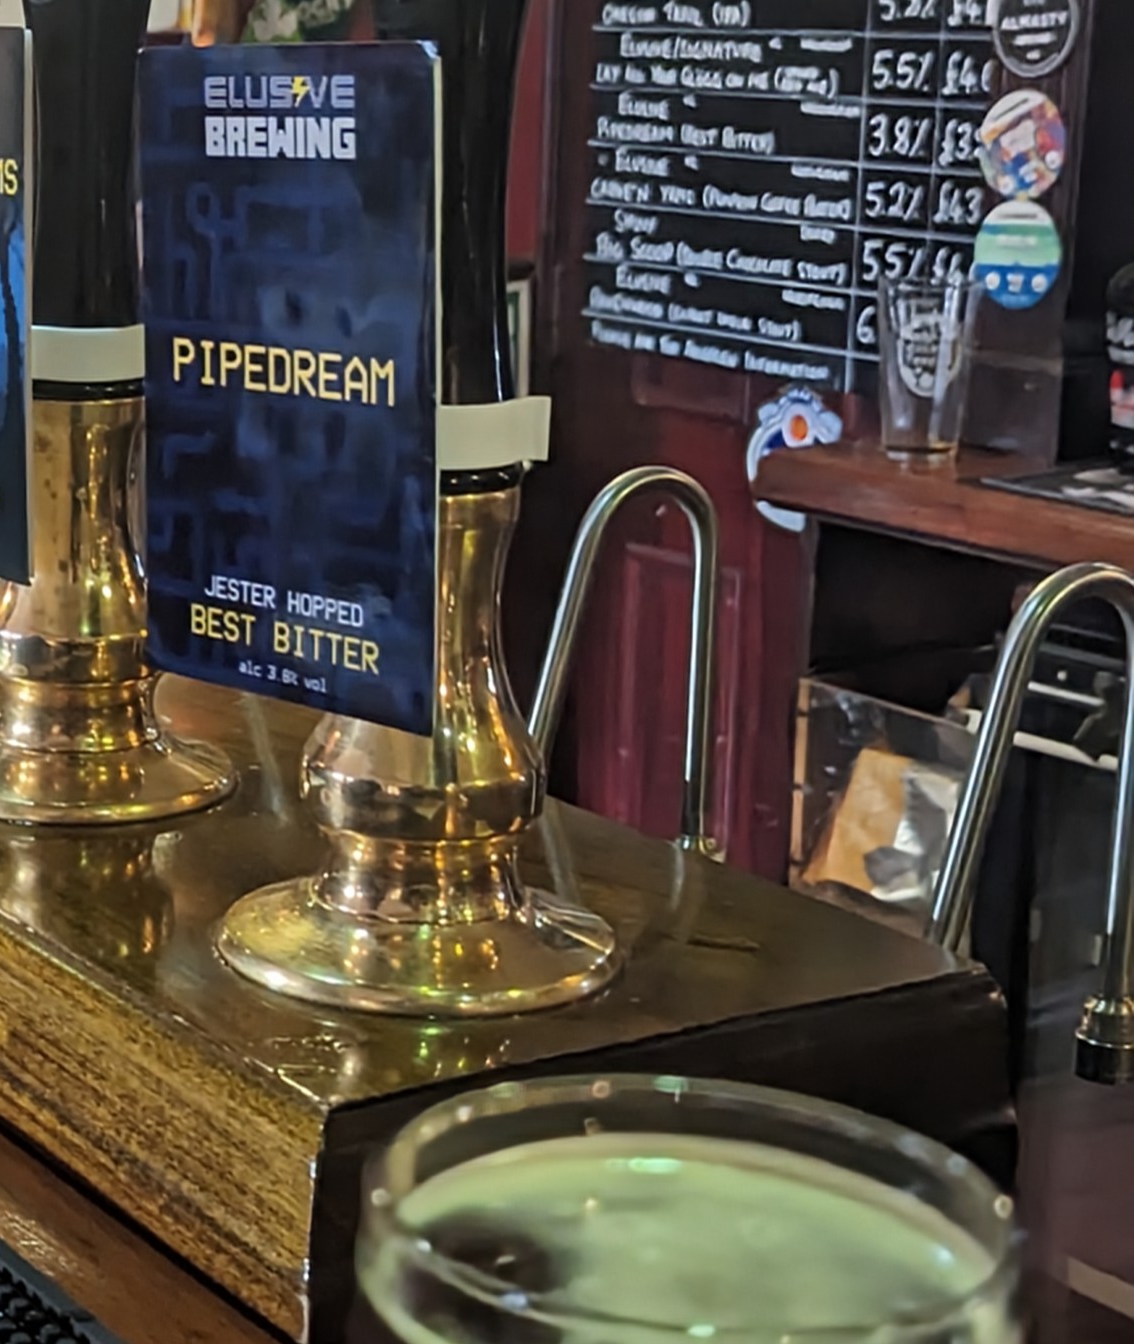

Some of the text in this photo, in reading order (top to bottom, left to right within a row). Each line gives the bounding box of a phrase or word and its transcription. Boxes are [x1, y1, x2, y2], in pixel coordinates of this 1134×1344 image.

[204, 75, 356, 109] ELUSIVE
[204, 116, 357, 160] BREWING
[173, 337, 395, 406] PIPEDREAM
[205, 575, 364, 628] JESTER HOPPED
[190, 604, 379, 676] BEST BITTER
[239, 660, 261, 678] alc
[304, 677, 327, 693] vol
